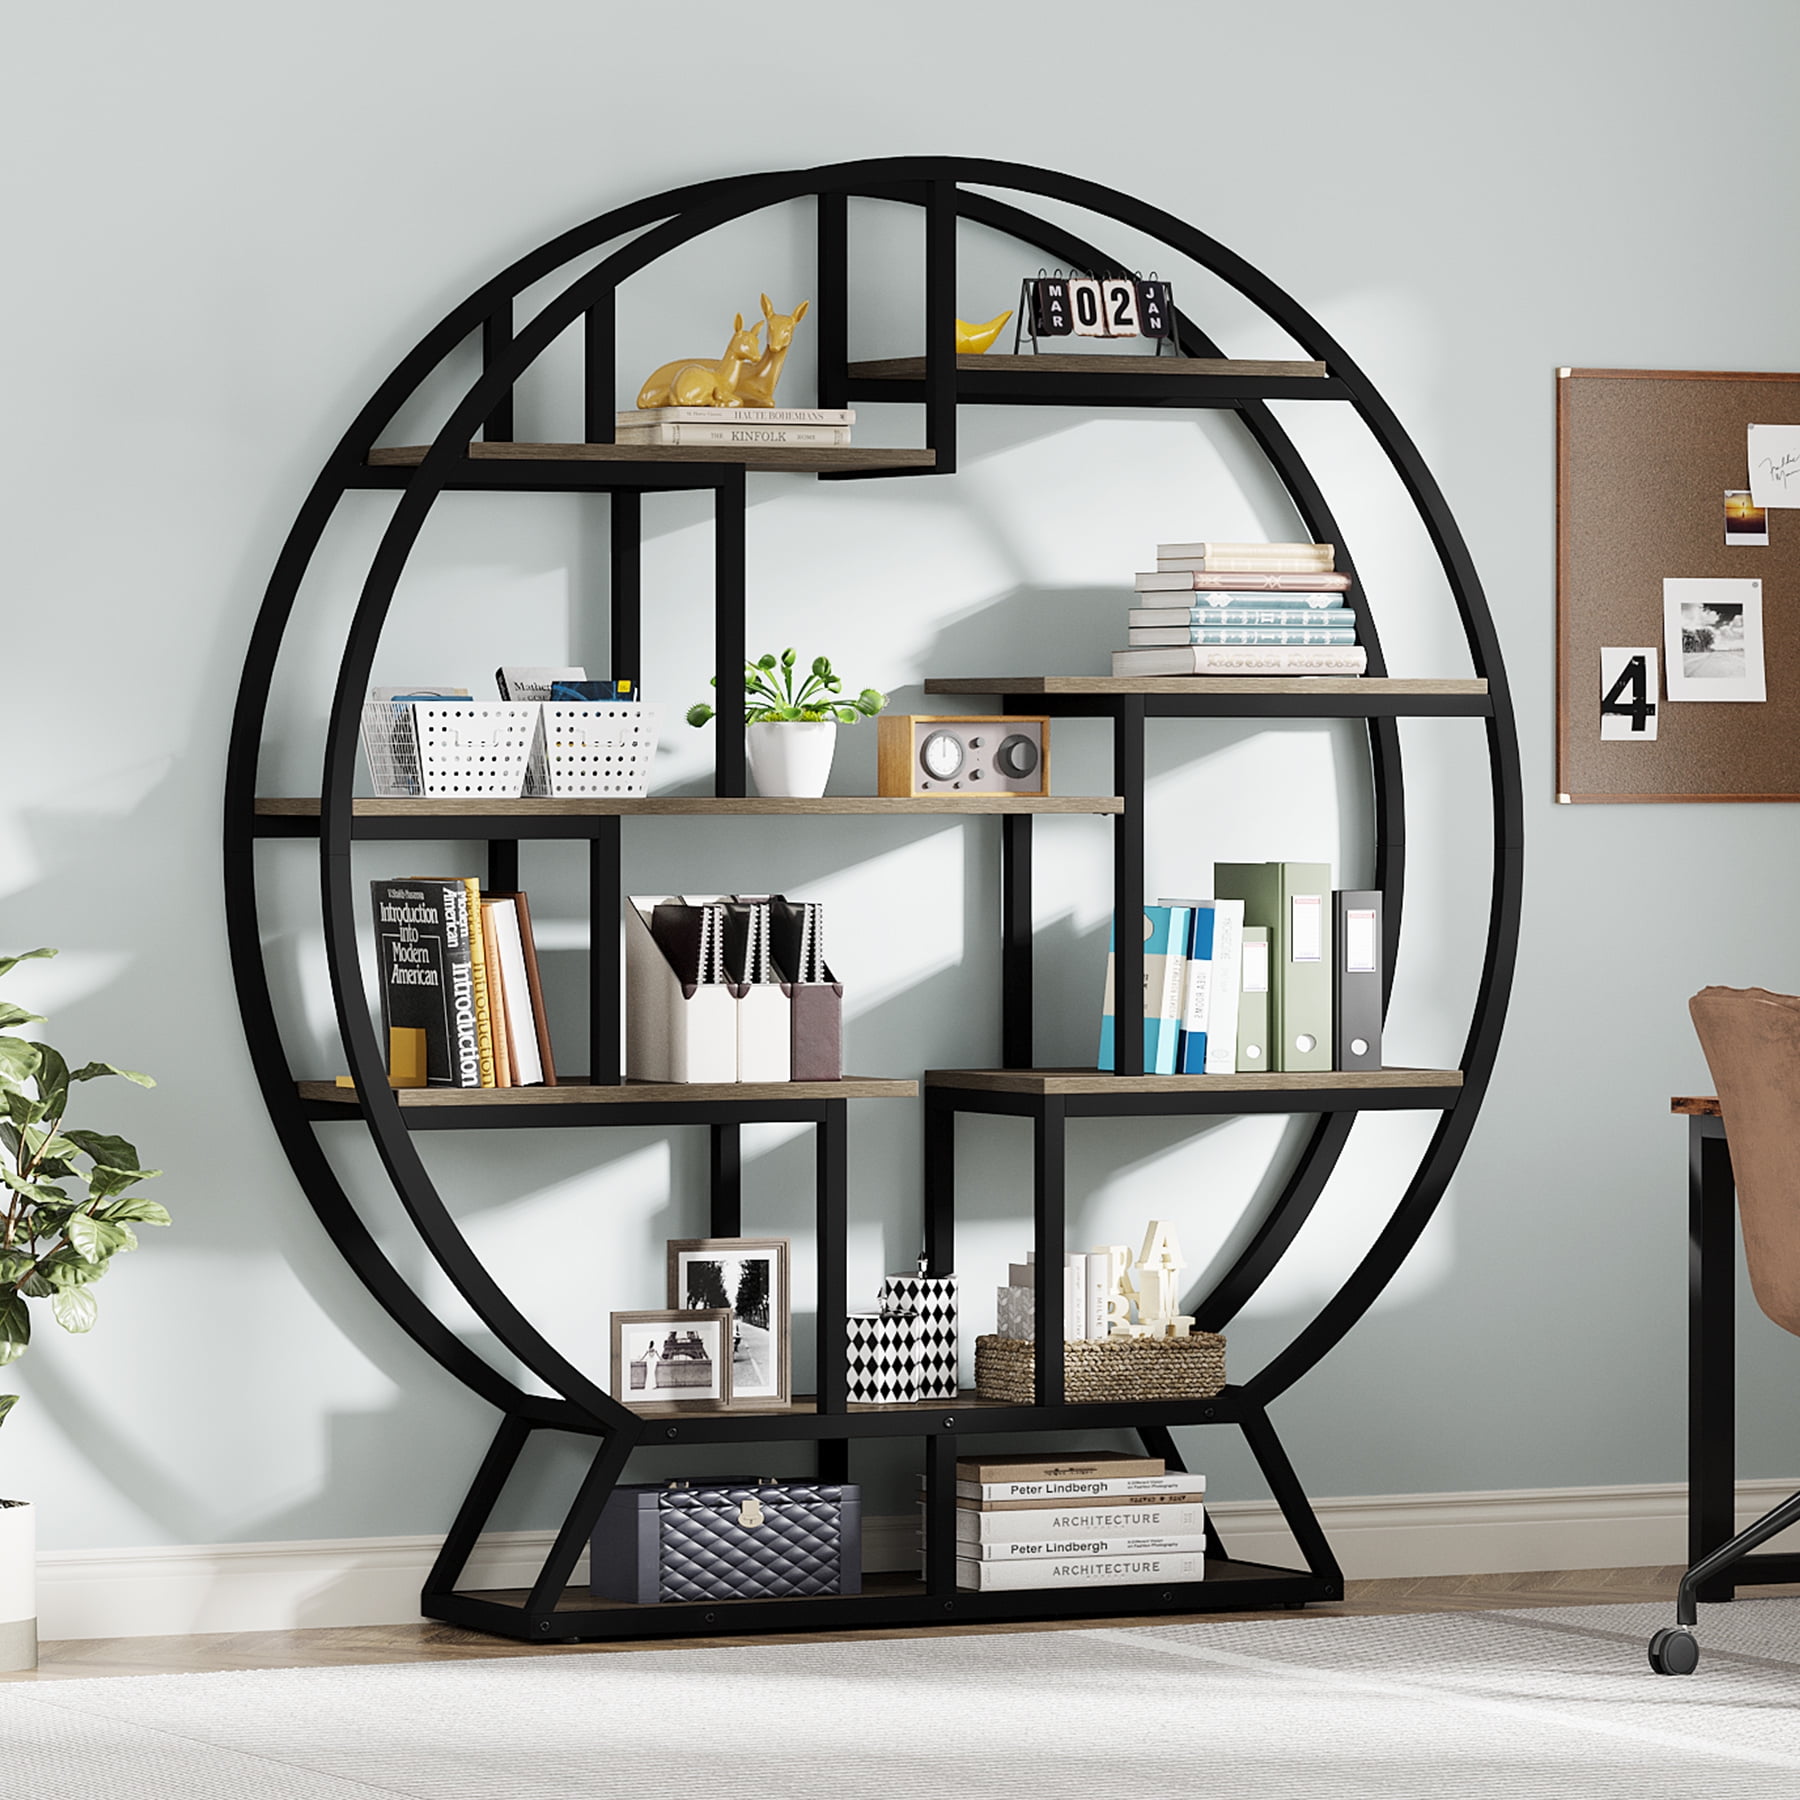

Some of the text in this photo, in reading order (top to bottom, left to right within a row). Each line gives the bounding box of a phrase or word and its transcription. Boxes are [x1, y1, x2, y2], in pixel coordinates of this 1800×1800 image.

[1048, 284, 1064, 328] MAR
[1145, 287, 1162, 329] JAN
[734, 411, 764, 420] HAUTE
[768, 411, 824, 421] BOHEMIANS
[731, 431, 787, 442] KINFOLK
[1601, 656, 1656, 731] 4
[379, 902, 439, 925] Introduction
[443, 887, 459, 948] American
[457, 890, 469, 938] Modern
[400, 926, 419, 943] into
[391, 942, 430, 964] Modern
[391, 964, 439, 986] American
[452, 961, 481, 1087] Introduction
[473, 962, 495, 1087] Introduction
[1010, 1482, 1109, 1496] Peter Lindbergh
[1052, 1512, 1161, 1527] ARCHITECTURE
[1010, 1542, 1109, 1556] Peter Lindbergh
[1052, 1561, 1161, 1576] ARCHITECTURE
